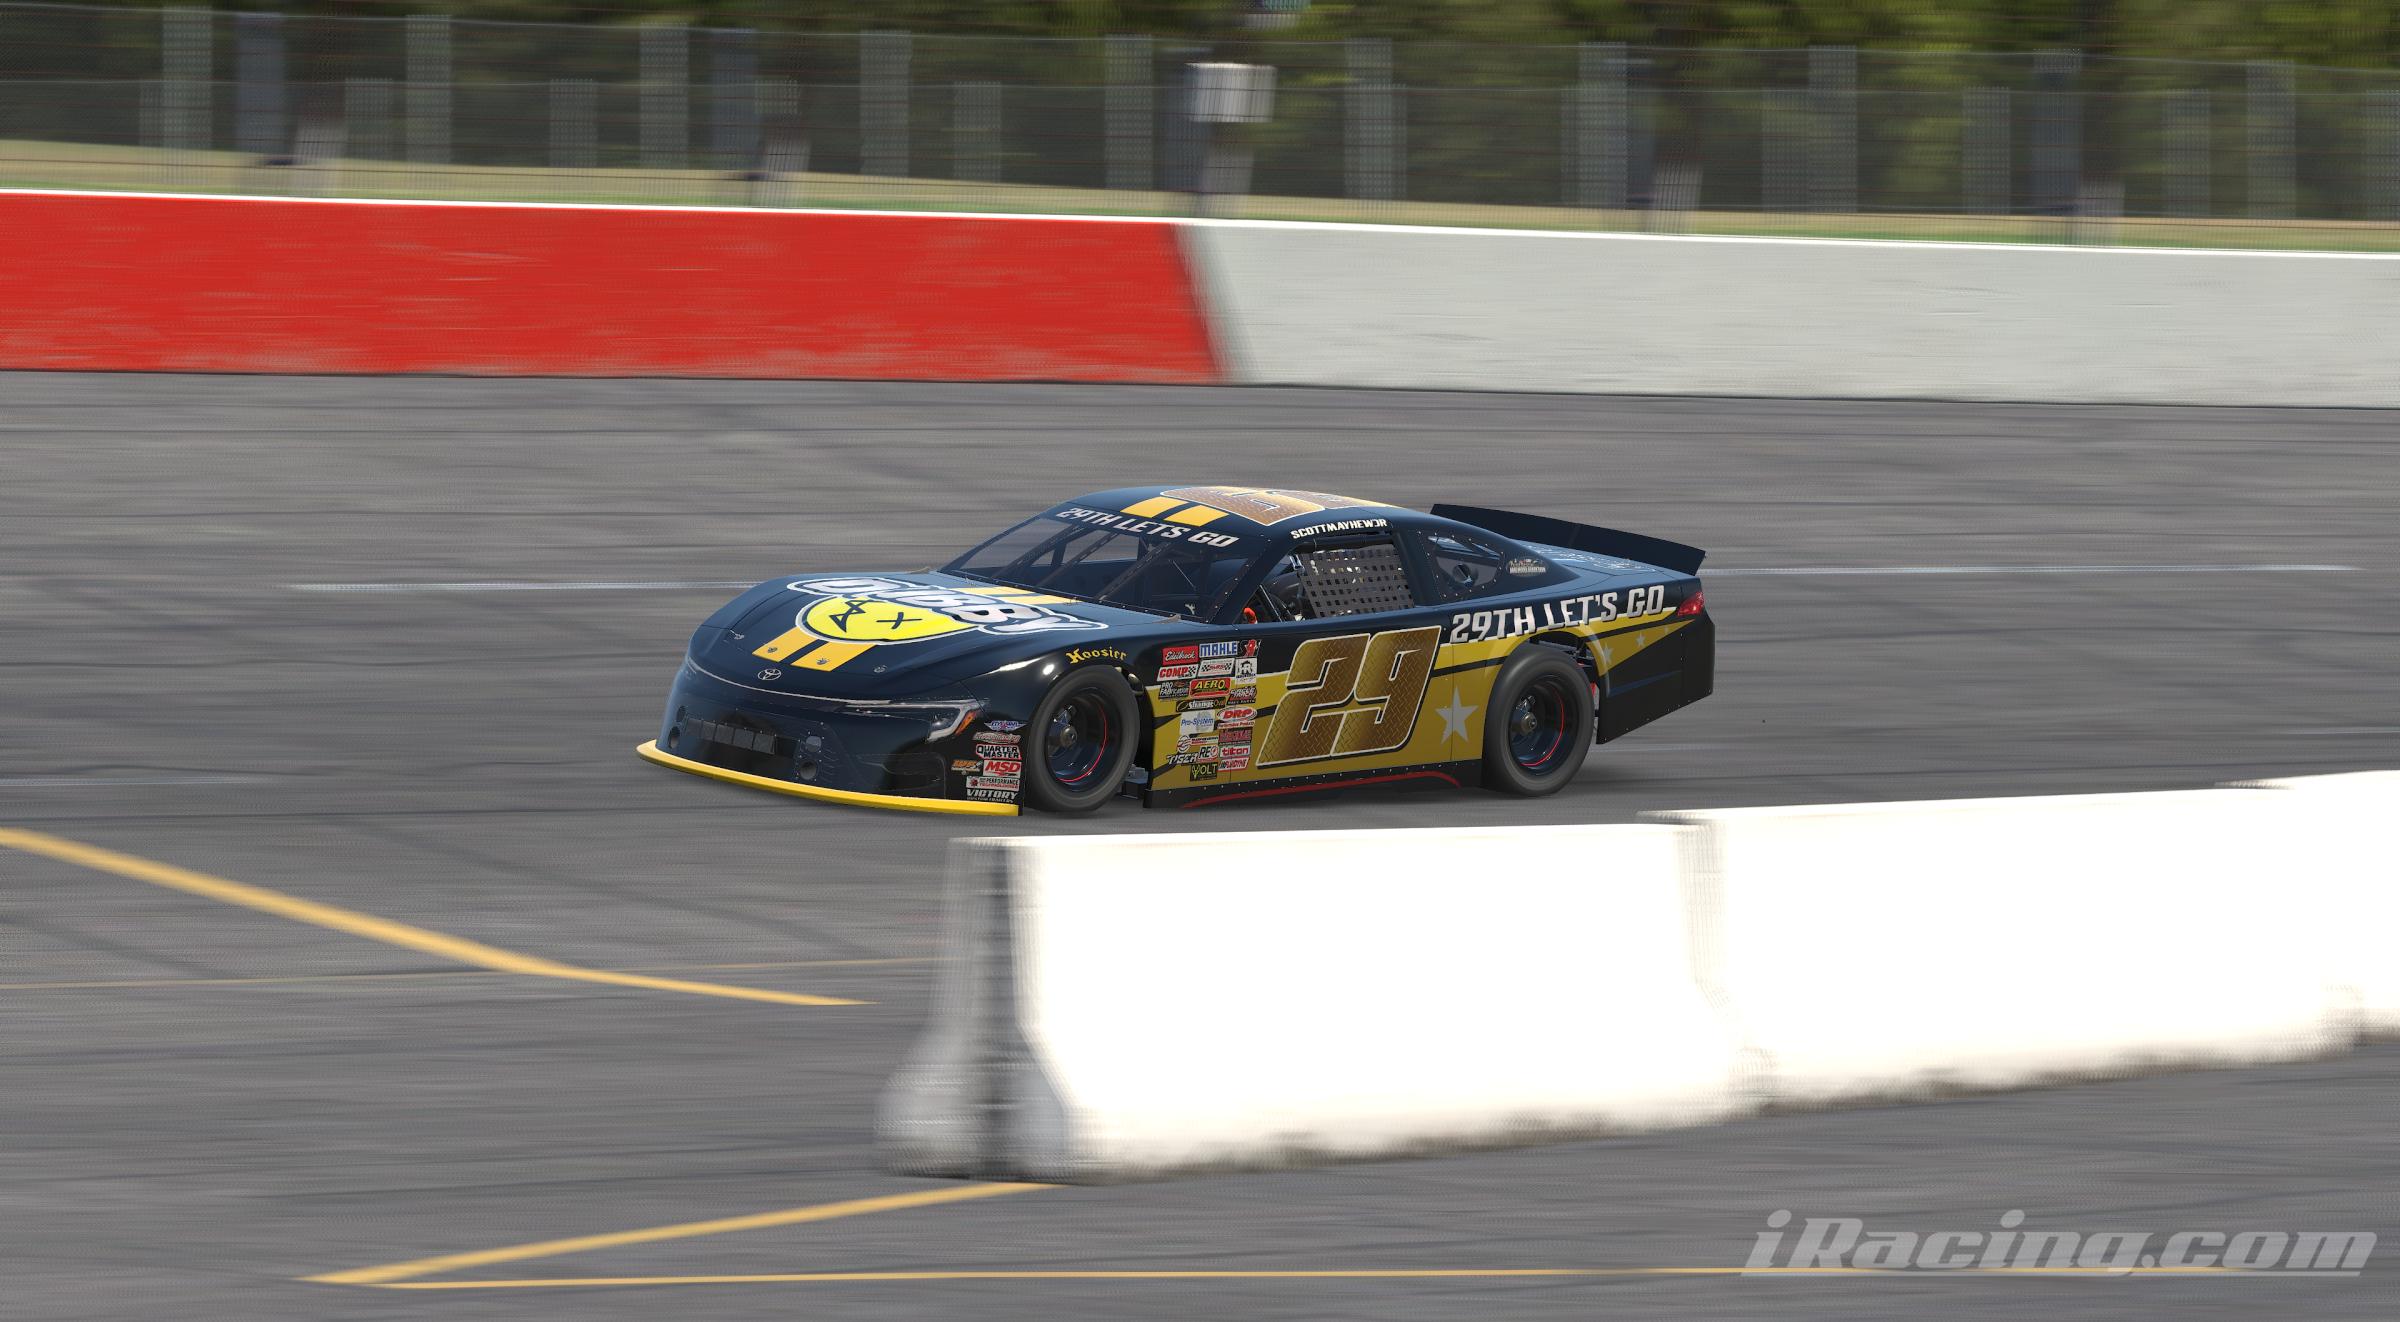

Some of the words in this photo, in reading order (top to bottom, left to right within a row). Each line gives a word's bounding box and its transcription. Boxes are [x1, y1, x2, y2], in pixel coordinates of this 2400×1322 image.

[1056, 507, 1113, 526] 29TH
[1117, 518, 1187, 539] LETS
[1188, 531, 1240, 548] GO
[1451, 606, 1537, 644] 29TH
[1544, 592, 1617, 630] LET'S
[1626, 585, 1666, 619] GO
[1065, 645, 1127, 664] Hoosier
[1200, 641, 1238, 656] MAHLE
[1159, 666, 1189, 678] COMP
[1195, 679, 1225, 690] AERO
[1256, 625, 1442, 769] 29
[1223, 708, 1253, 719] DRP
[977, 745, 1017, 754] QUARTER
[985, 761, 1021, 773] MSD
[1191, 764, 1217, 777] VOLT
[967, 788, 1018, 800] VICTORY
